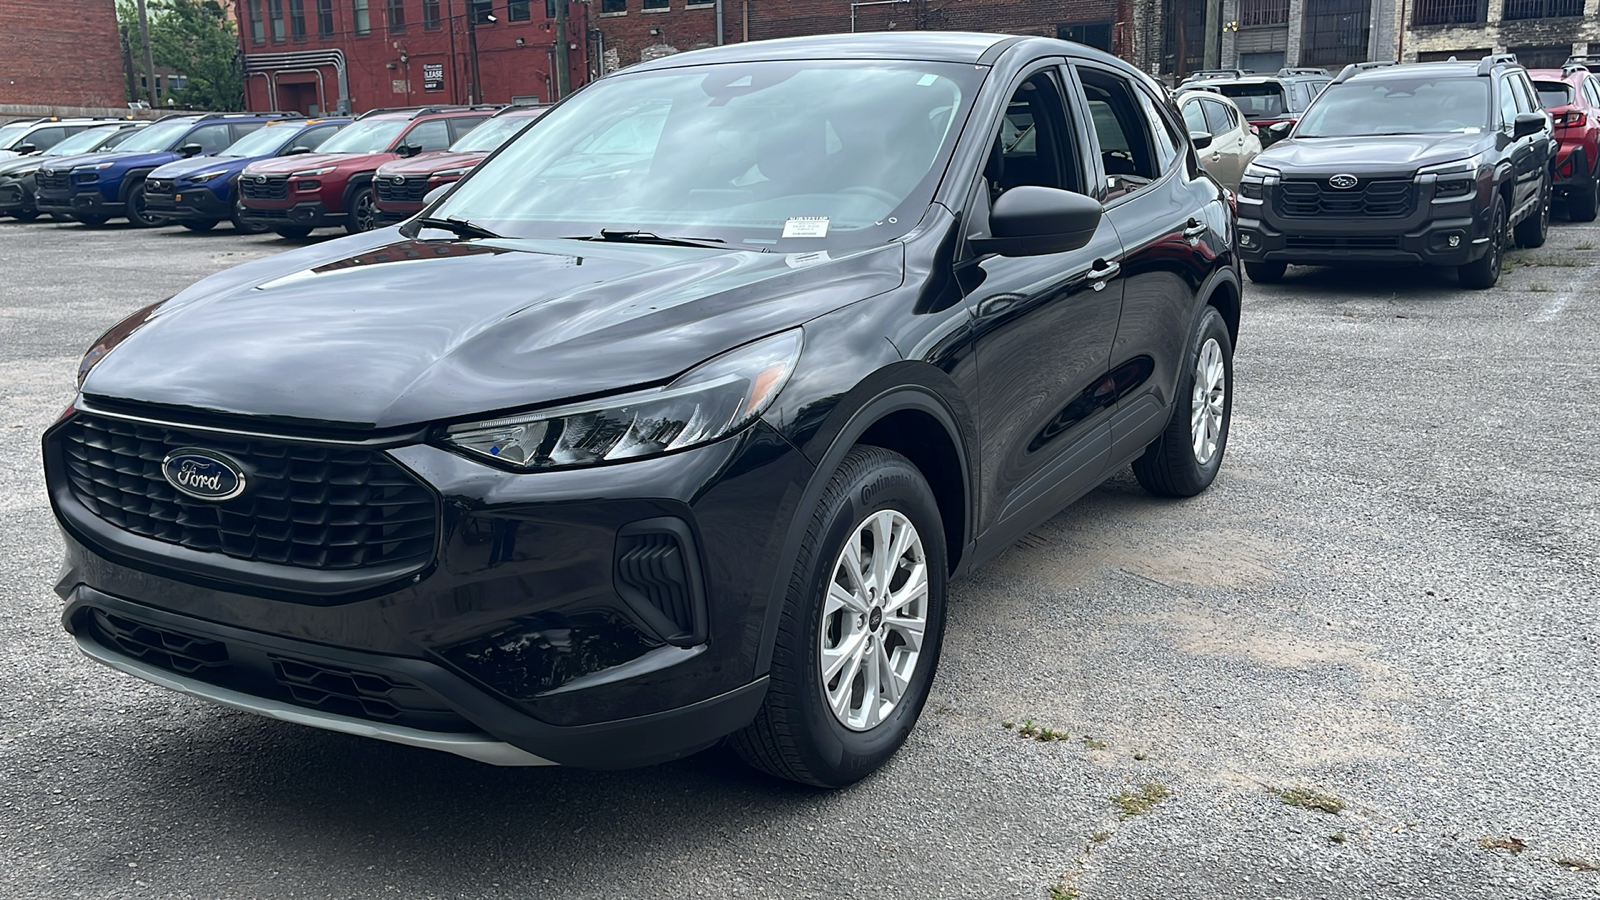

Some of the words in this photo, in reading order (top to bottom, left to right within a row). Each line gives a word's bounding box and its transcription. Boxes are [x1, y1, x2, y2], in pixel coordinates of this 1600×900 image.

[427, 70, 443, 78] LEASE
[177, 459, 222, 491] Ford
[861, 473, 913, 506] Continental
